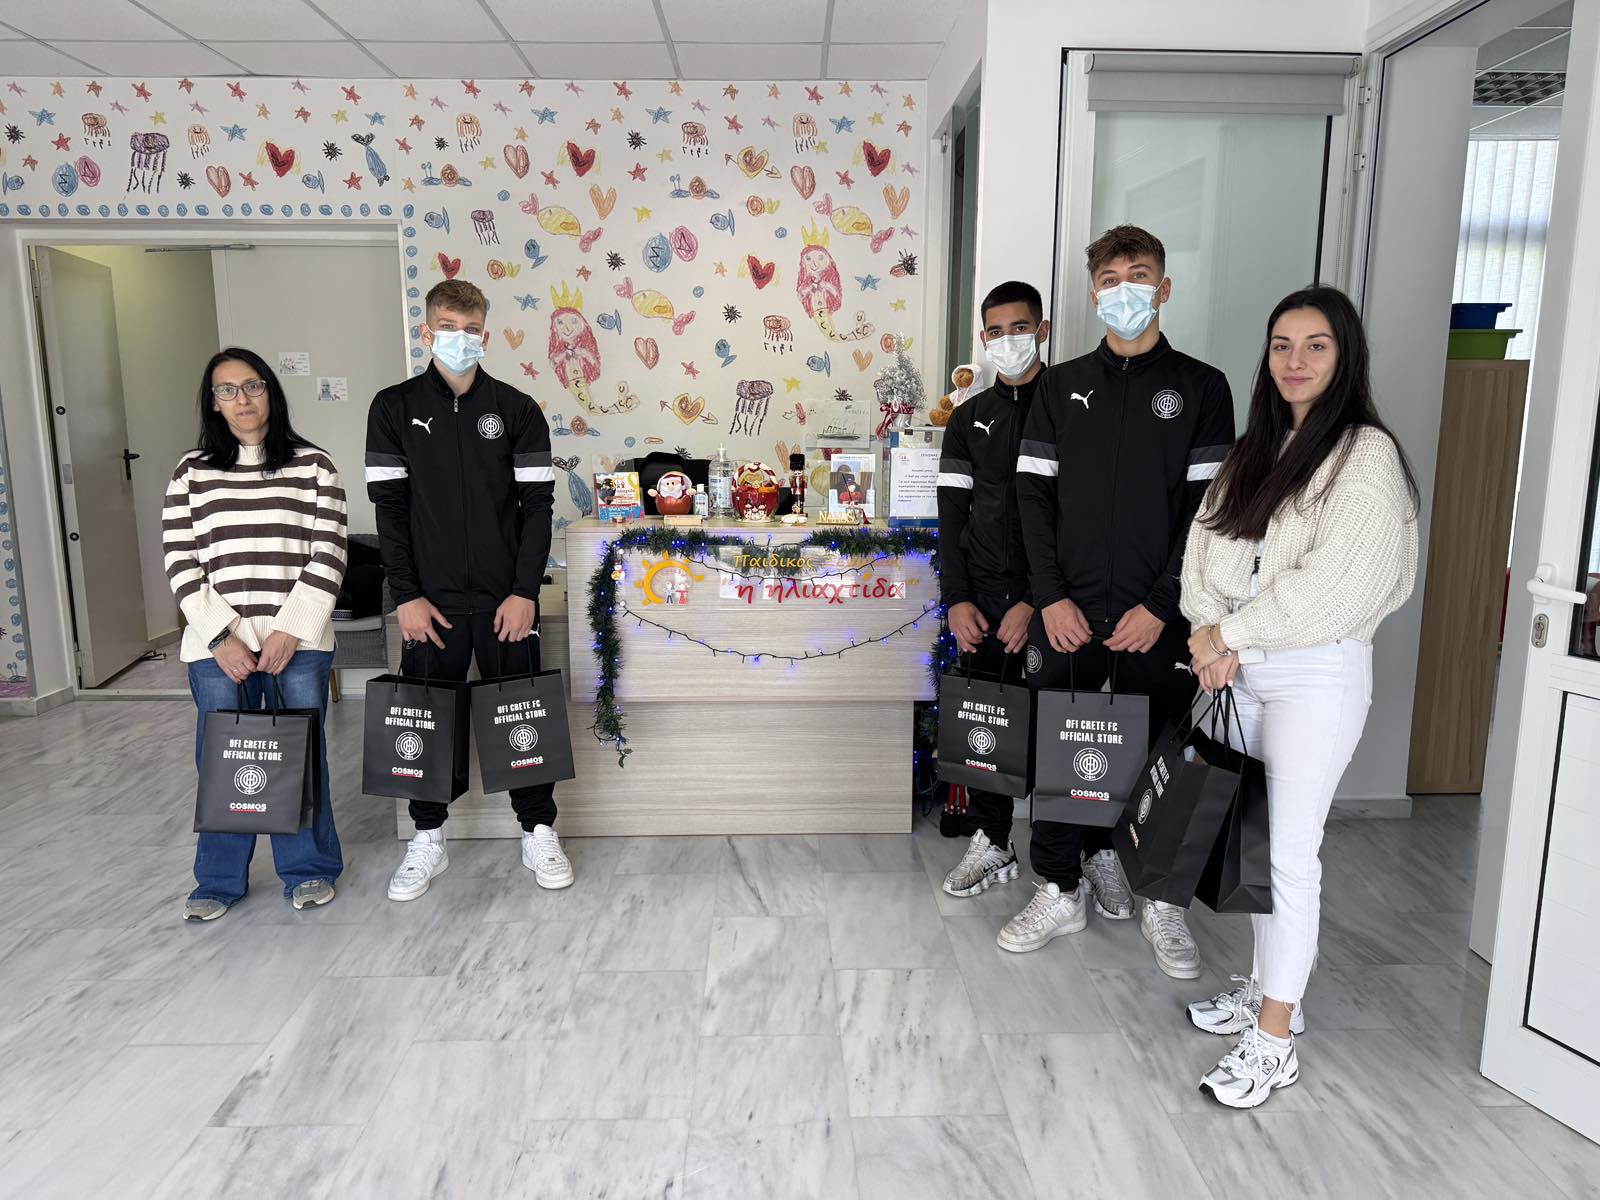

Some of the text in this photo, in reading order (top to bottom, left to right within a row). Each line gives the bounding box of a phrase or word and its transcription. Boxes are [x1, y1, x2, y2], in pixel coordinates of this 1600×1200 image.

[390, 706, 432, 719] OFI CRETE FC
[497, 699, 541, 714] OFI CRETE FC
[962, 700, 1006, 716] OFI CRETE FC
[385, 716, 436, 730] OFFICIAL STORE
[494, 708, 547, 725] OFFICIAL STORE
[957, 710, 1009, 727] OFFICIAL STORE
[1065, 719, 1118, 732] OFI CRETE FC
[229, 738, 278, 750] OFI CRETE FC
[1060, 731, 1123, 745] OFFICIAL STORE
[223, 749, 283, 761] OFFICIAL STORE
[510, 756, 544, 767] COSMOS
[391, 767, 424, 776] COSMOS
[965, 759, 997, 771] COSMOS
[1070, 789, 1110, 799] COSMOS
[229, 802, 267, 810] COSMOS
